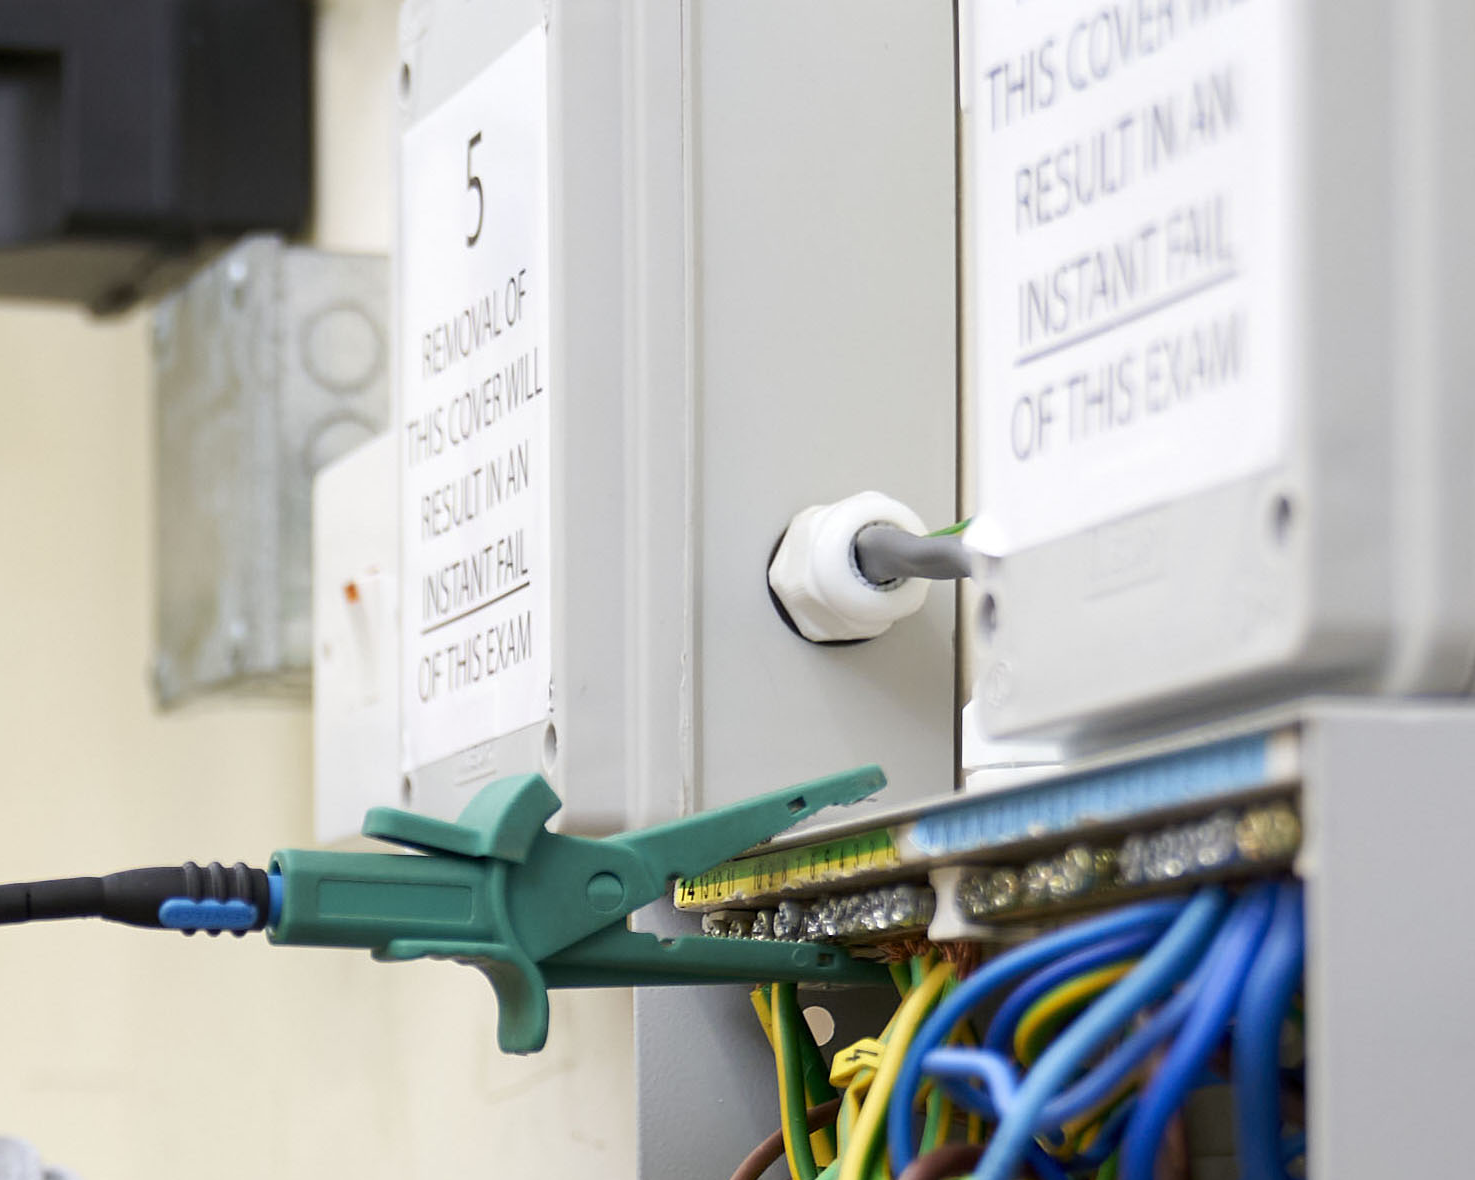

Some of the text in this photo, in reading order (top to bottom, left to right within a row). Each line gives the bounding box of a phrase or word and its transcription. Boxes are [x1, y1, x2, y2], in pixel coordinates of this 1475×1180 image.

[986, 0, 1174, 132] THIS COVER
[466, 130, 484, 248] 5
[1015, 69, 1238, 235] RESULT IN AN
[421, 268, 526, 380] REMOVAL OF
[1019, 195, 1233, 347] INSTANT FAIL
[406, 346, 543, 468] THIS COVER WILL
[1011, 311, 1243, 461] OF THIS EXAM
[421, 439, 529, 541] RESULT IN AN
[422, 527, 529, 621] INSTANT FAIL
[418, 610, 532, 704] OF THIS EXAM
